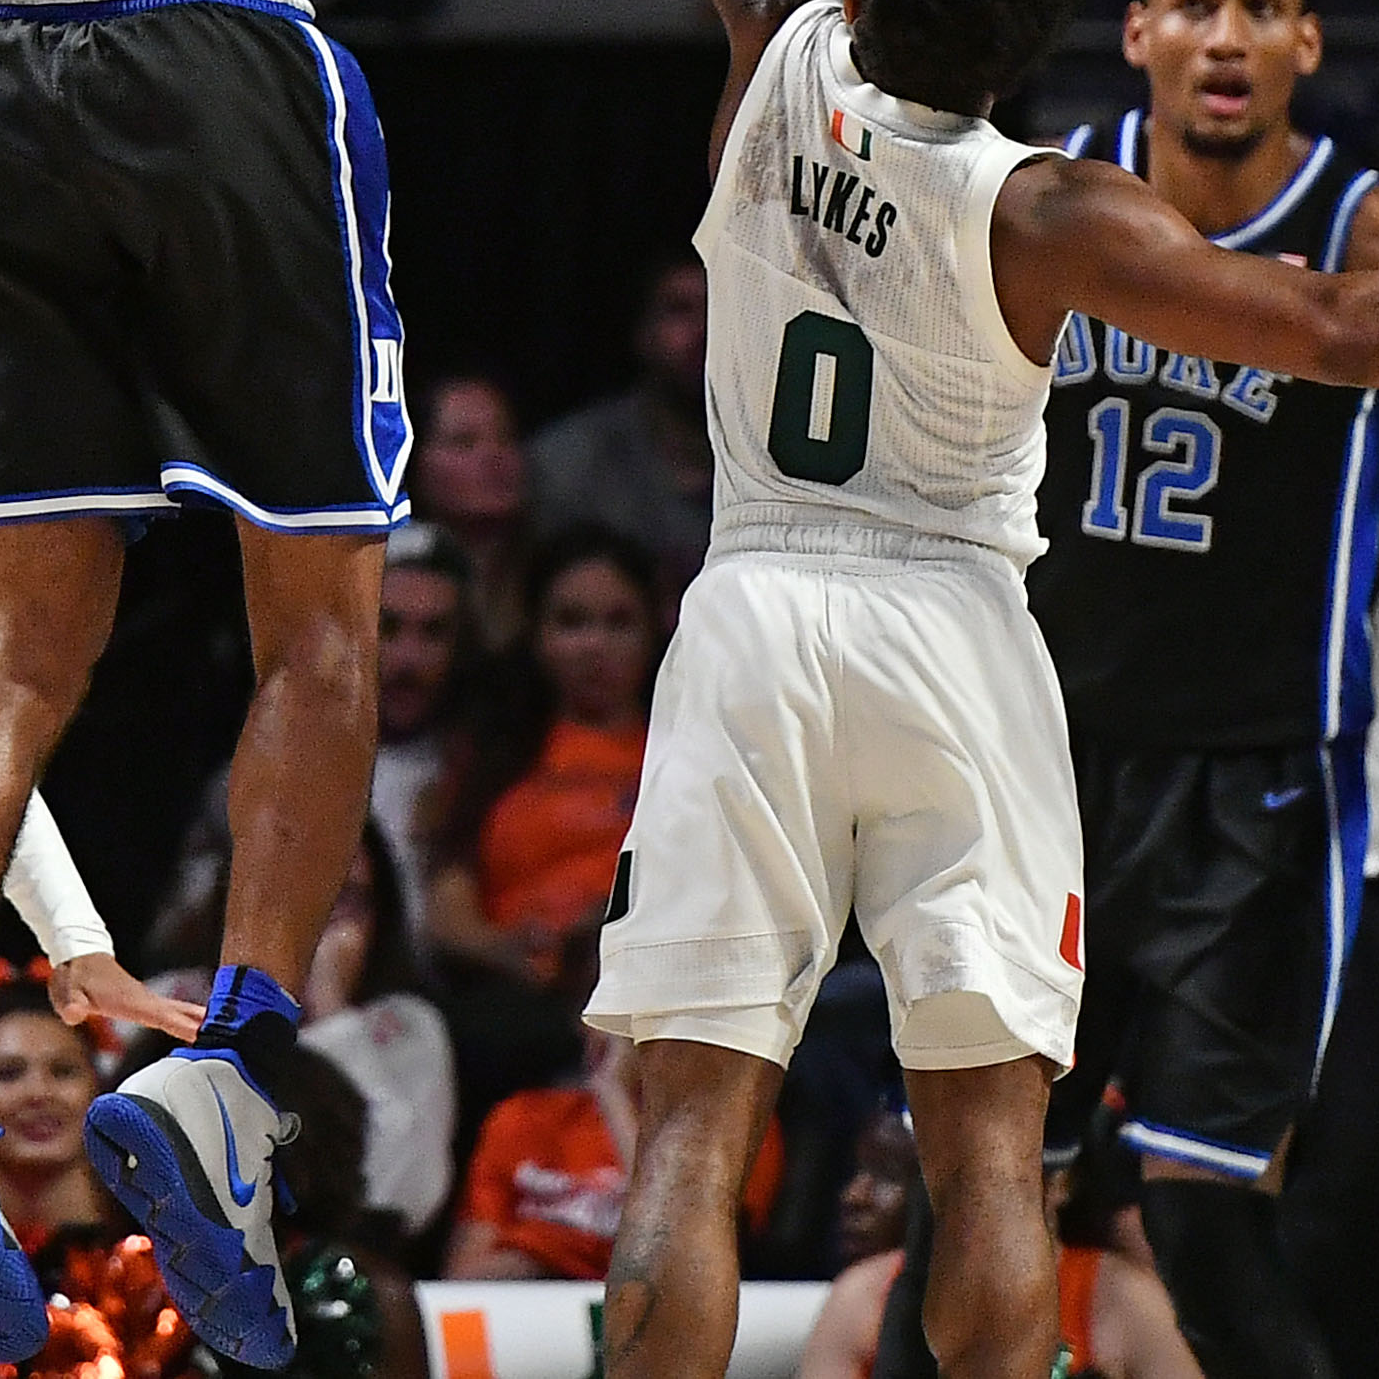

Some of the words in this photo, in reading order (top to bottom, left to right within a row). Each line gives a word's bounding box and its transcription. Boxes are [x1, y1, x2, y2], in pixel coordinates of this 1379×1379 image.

[790, 155, 897, 258] LYKES
[768, 310, 874, 486] 0
[1080, 395, 1221, 554] 12
